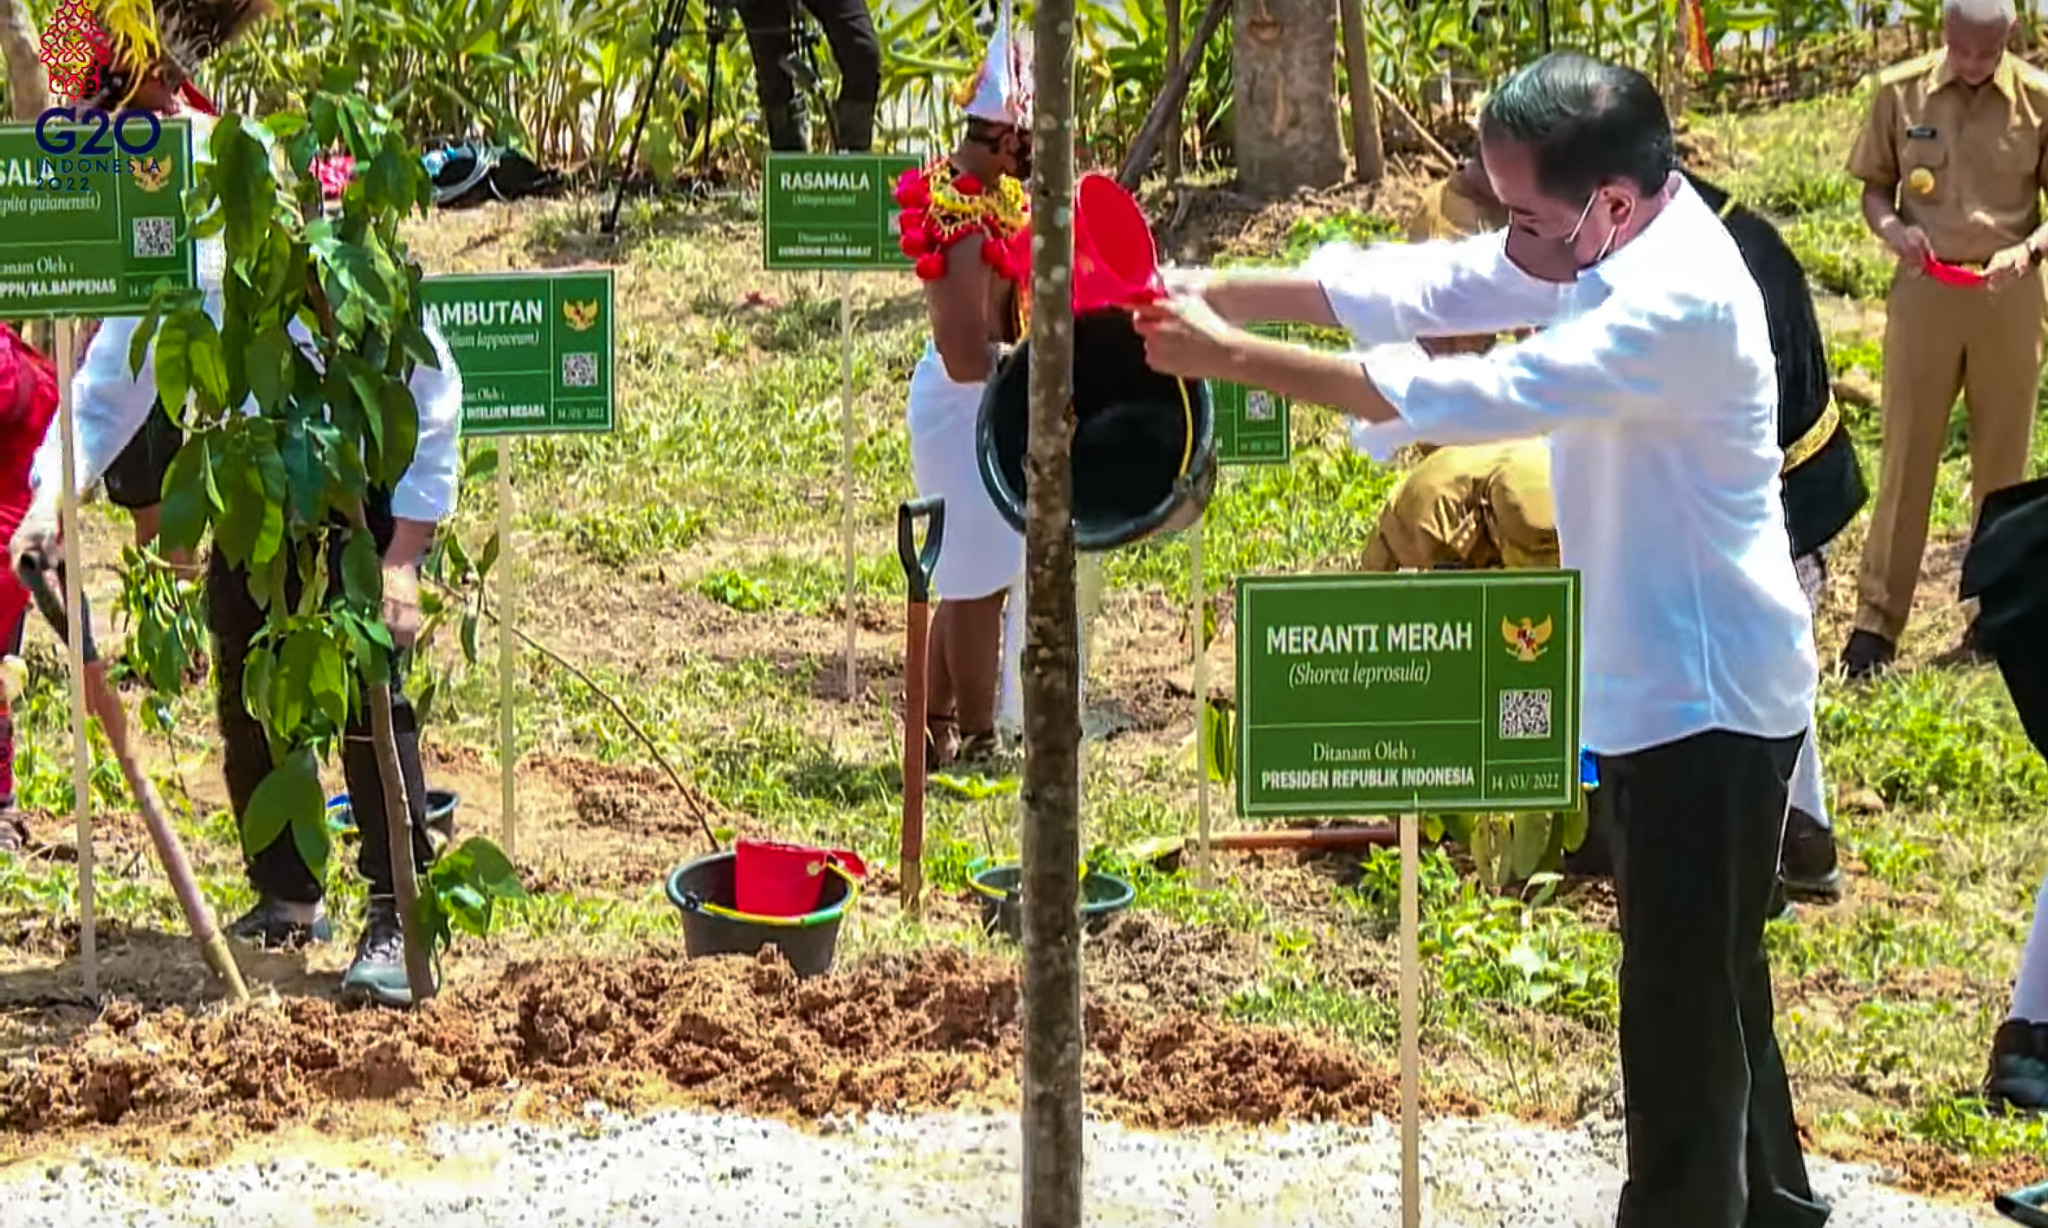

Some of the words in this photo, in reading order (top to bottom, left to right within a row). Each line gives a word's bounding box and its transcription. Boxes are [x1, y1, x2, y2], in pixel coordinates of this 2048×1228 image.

[780, 171, 870, 191] RASAMALA
[37, 255, 67, 275] Oleh
[424, 299, 543, 327] AMBUTAN
[1266, 623, 1379, 655] MERANTI
[1387, 621, 1473, 653] MERAH
[1288, 661, 1348, 689] (Shorea
[1352, 659, 1432, 689] leprosula)
[1313, 741, 1371, 762] Ditanam
[1375, 739, 1407, 761] Oleh
[1261, 768, 1329, 790] PRESIDEN
[1332, 767, 1399, 789] REPUBLIK
[1402, 765, 1475, 787] INDONESIA
